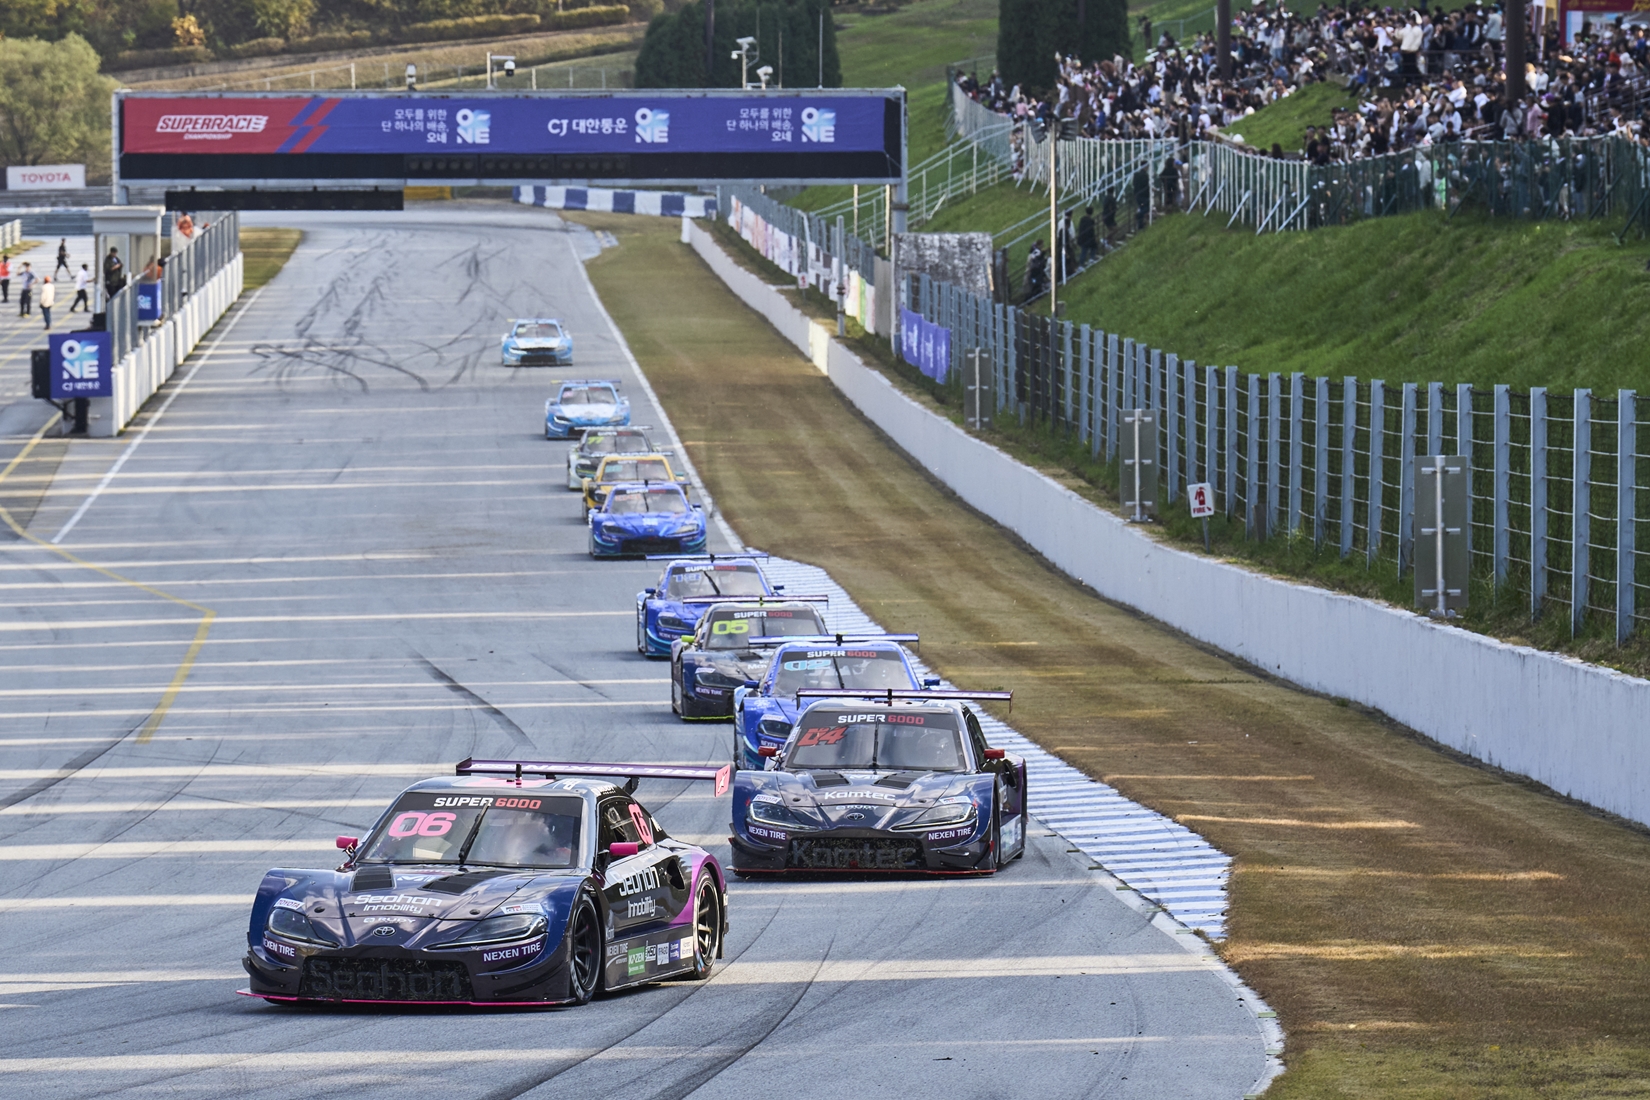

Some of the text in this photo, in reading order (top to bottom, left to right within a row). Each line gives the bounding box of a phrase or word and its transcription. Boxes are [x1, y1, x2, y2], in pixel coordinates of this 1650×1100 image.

[395, 108, 447, 120] 모두를 위한
[772, 107, 793, 119] 위한
[156, 114, 269, 132] SUPERRACE
[381, 120, 392, 132] 단
[394, 120, 424, 132] 하나의
[547, 118, 628, 136] CJ 대한통운
[726, 119, 737, 131] 단
[739, 119, 769, 131] 하나의
[426, 132, 447, 144] 오네
[771, 131, 792, 142] 오네
[21, 172, 71, 184] TOYOTA
[712, 619, 749, 635] 05
[784, 659, 831, 671] 02
[838, 714, 925, 725] SUPER 6000
[524, 764, 636, 773] NEXEN
[643, 767, 715, 776] TIRE
[756, 794, 778, 803] TOYOTA
[824, 790, 896, 800] Kamtec
[433, 797, 542, 809] SUPER 6000
[388, 812, 457, 837] 06
[748, 825, 786, 840] NEXEN TIRE
[928, 827, 971, 841] NEXEN TIRE
[792, 839, 917, 869] Kamtec
[277, 899, 300, 909] TOYOTA
[354, 894, 443, 907] Seohan
[363, 904, 424, 914] Innobility
[278, 944, 295, 957] TIRE
[483, 941, 541, 962] NEXEN TIRE
